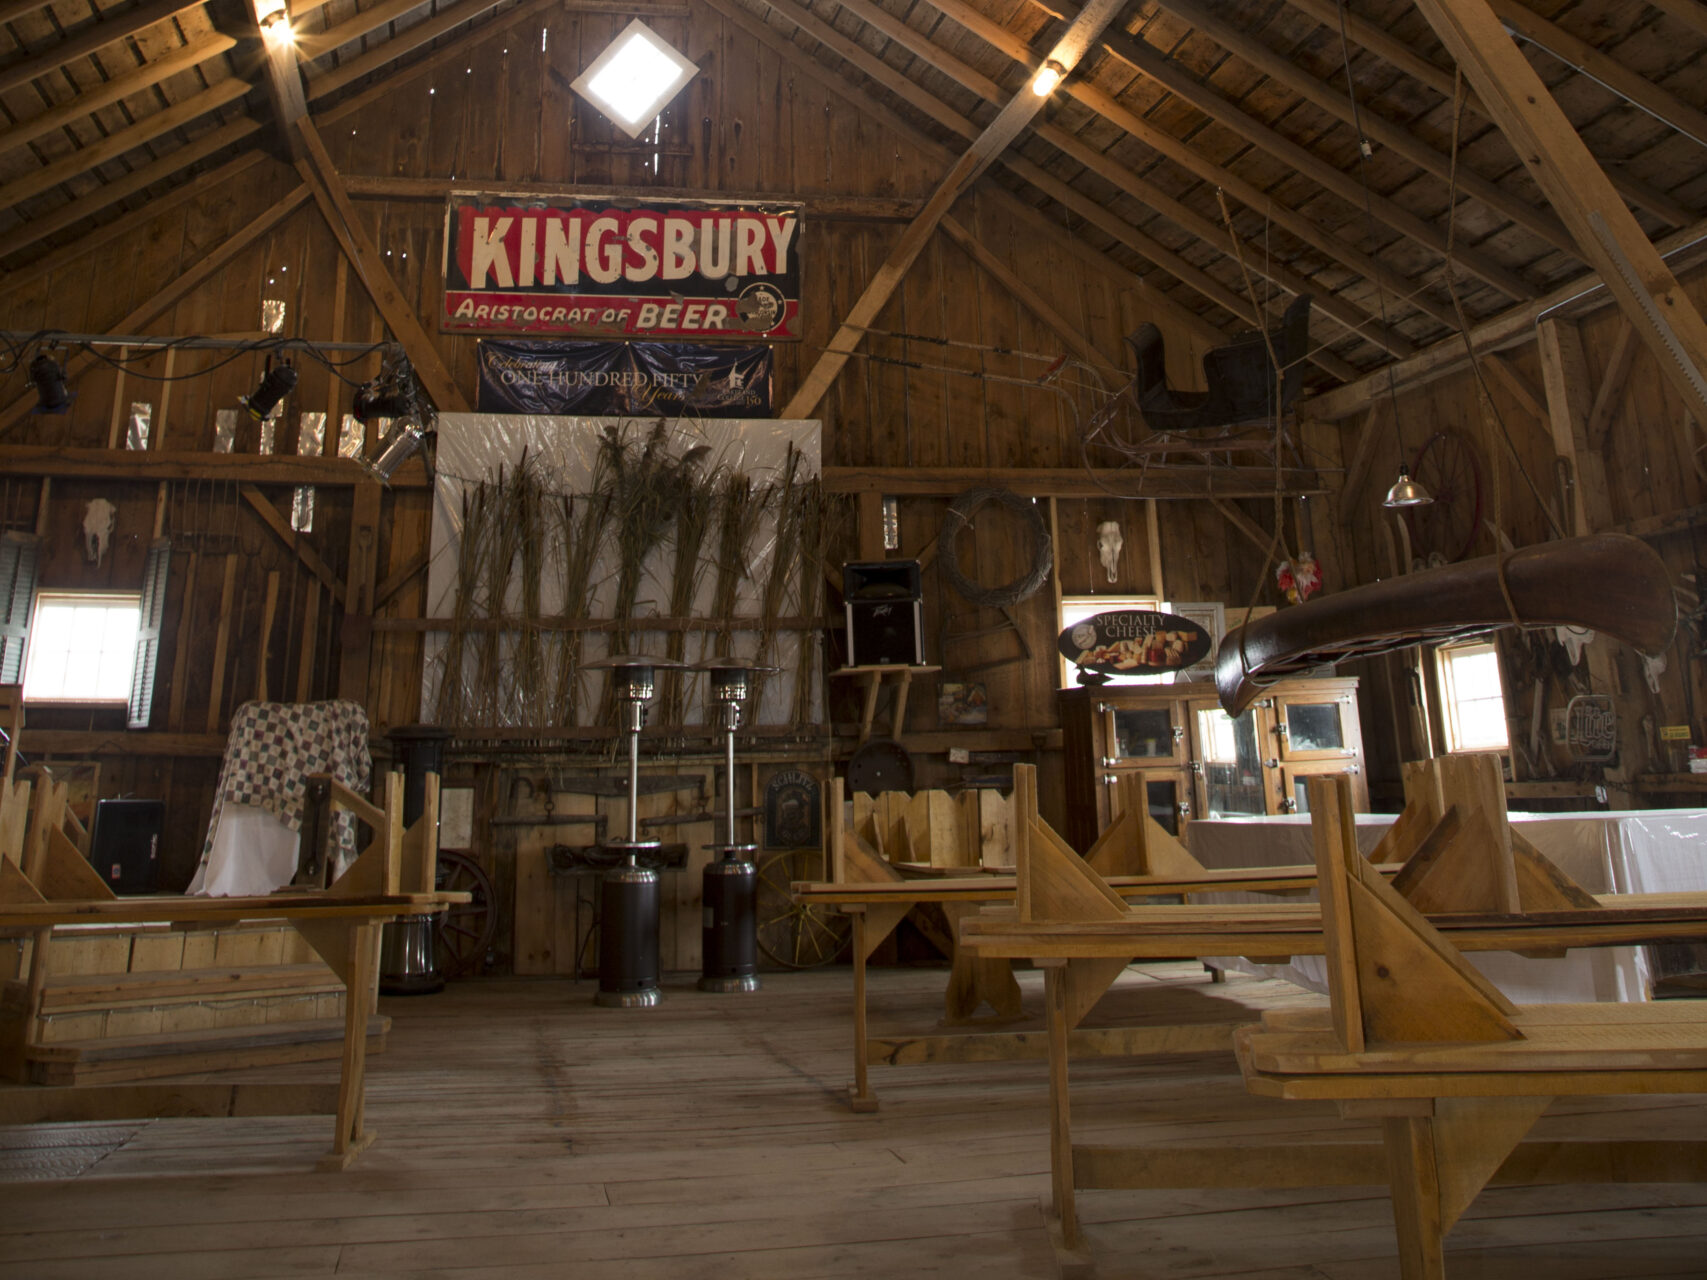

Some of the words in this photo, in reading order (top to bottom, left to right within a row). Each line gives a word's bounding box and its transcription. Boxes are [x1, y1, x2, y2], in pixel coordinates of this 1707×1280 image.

[470, 216, 797, 290] KINGSBURY
[455, 298, 595, 322] ARISTOCRAT
[602, 308, 631, 322] OF
[636, 303, 728, 329] BEER
[501, 370, 543, 385] ONE
[549, 368, 648, 387] HUNDRED
[653, 373, 703, 388] FIFTY
[1096, 614, 1166, 626] SPECIALTY
[1105, 625, 1157, 638] CHEESE
[1572, 704, 1616, 742] Lite
[772, 771, 814, 792] SCHLITZ
